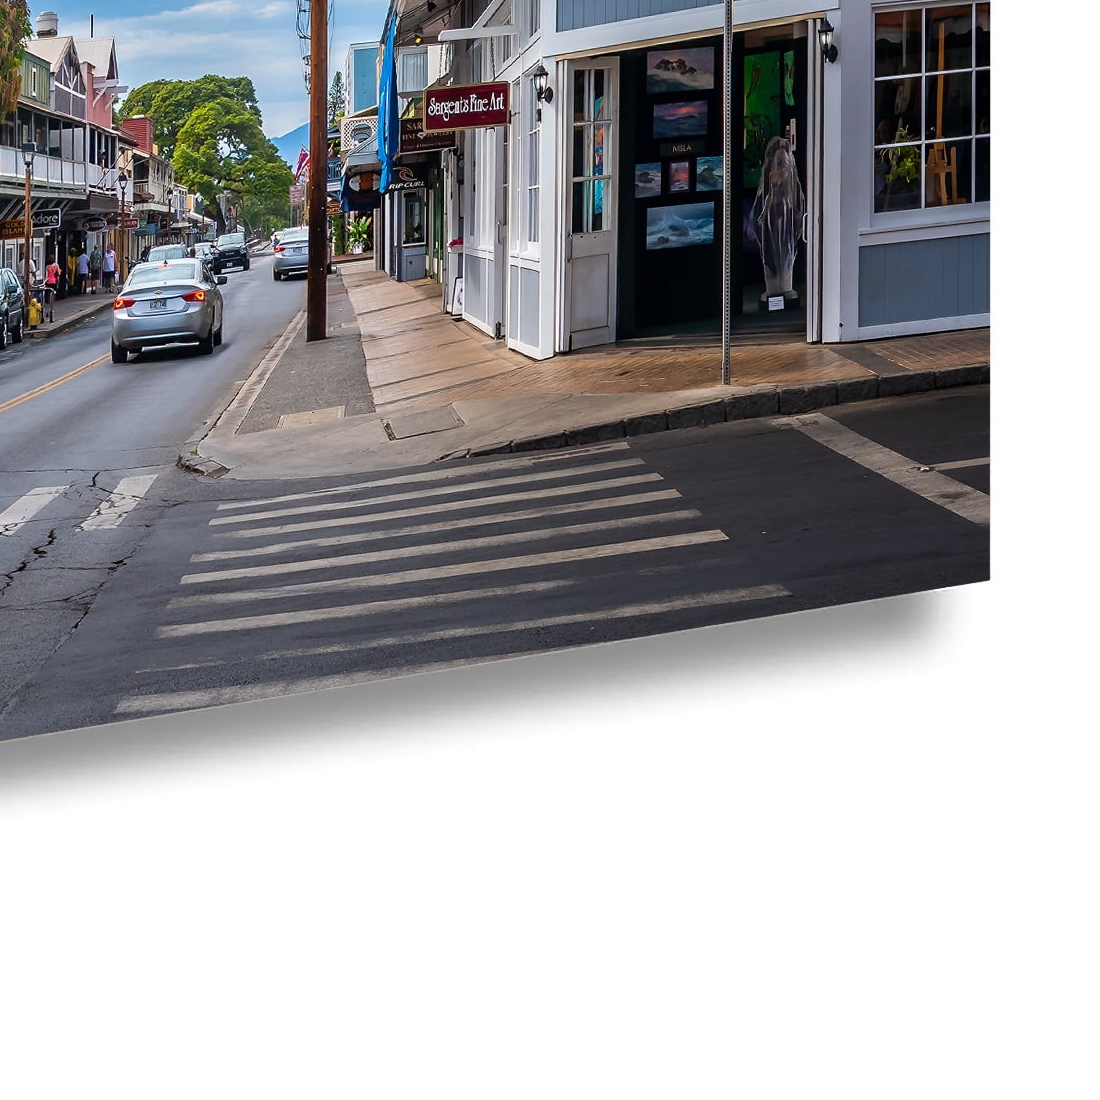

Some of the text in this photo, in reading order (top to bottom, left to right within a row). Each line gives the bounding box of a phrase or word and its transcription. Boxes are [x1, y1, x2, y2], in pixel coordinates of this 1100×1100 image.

[470, 93, 488, 112] Fine
[489, 91, 505, 111] Art
[388, 180, 426, 190] RIP CURL
[2, 227, 26, 235] ISLAN
